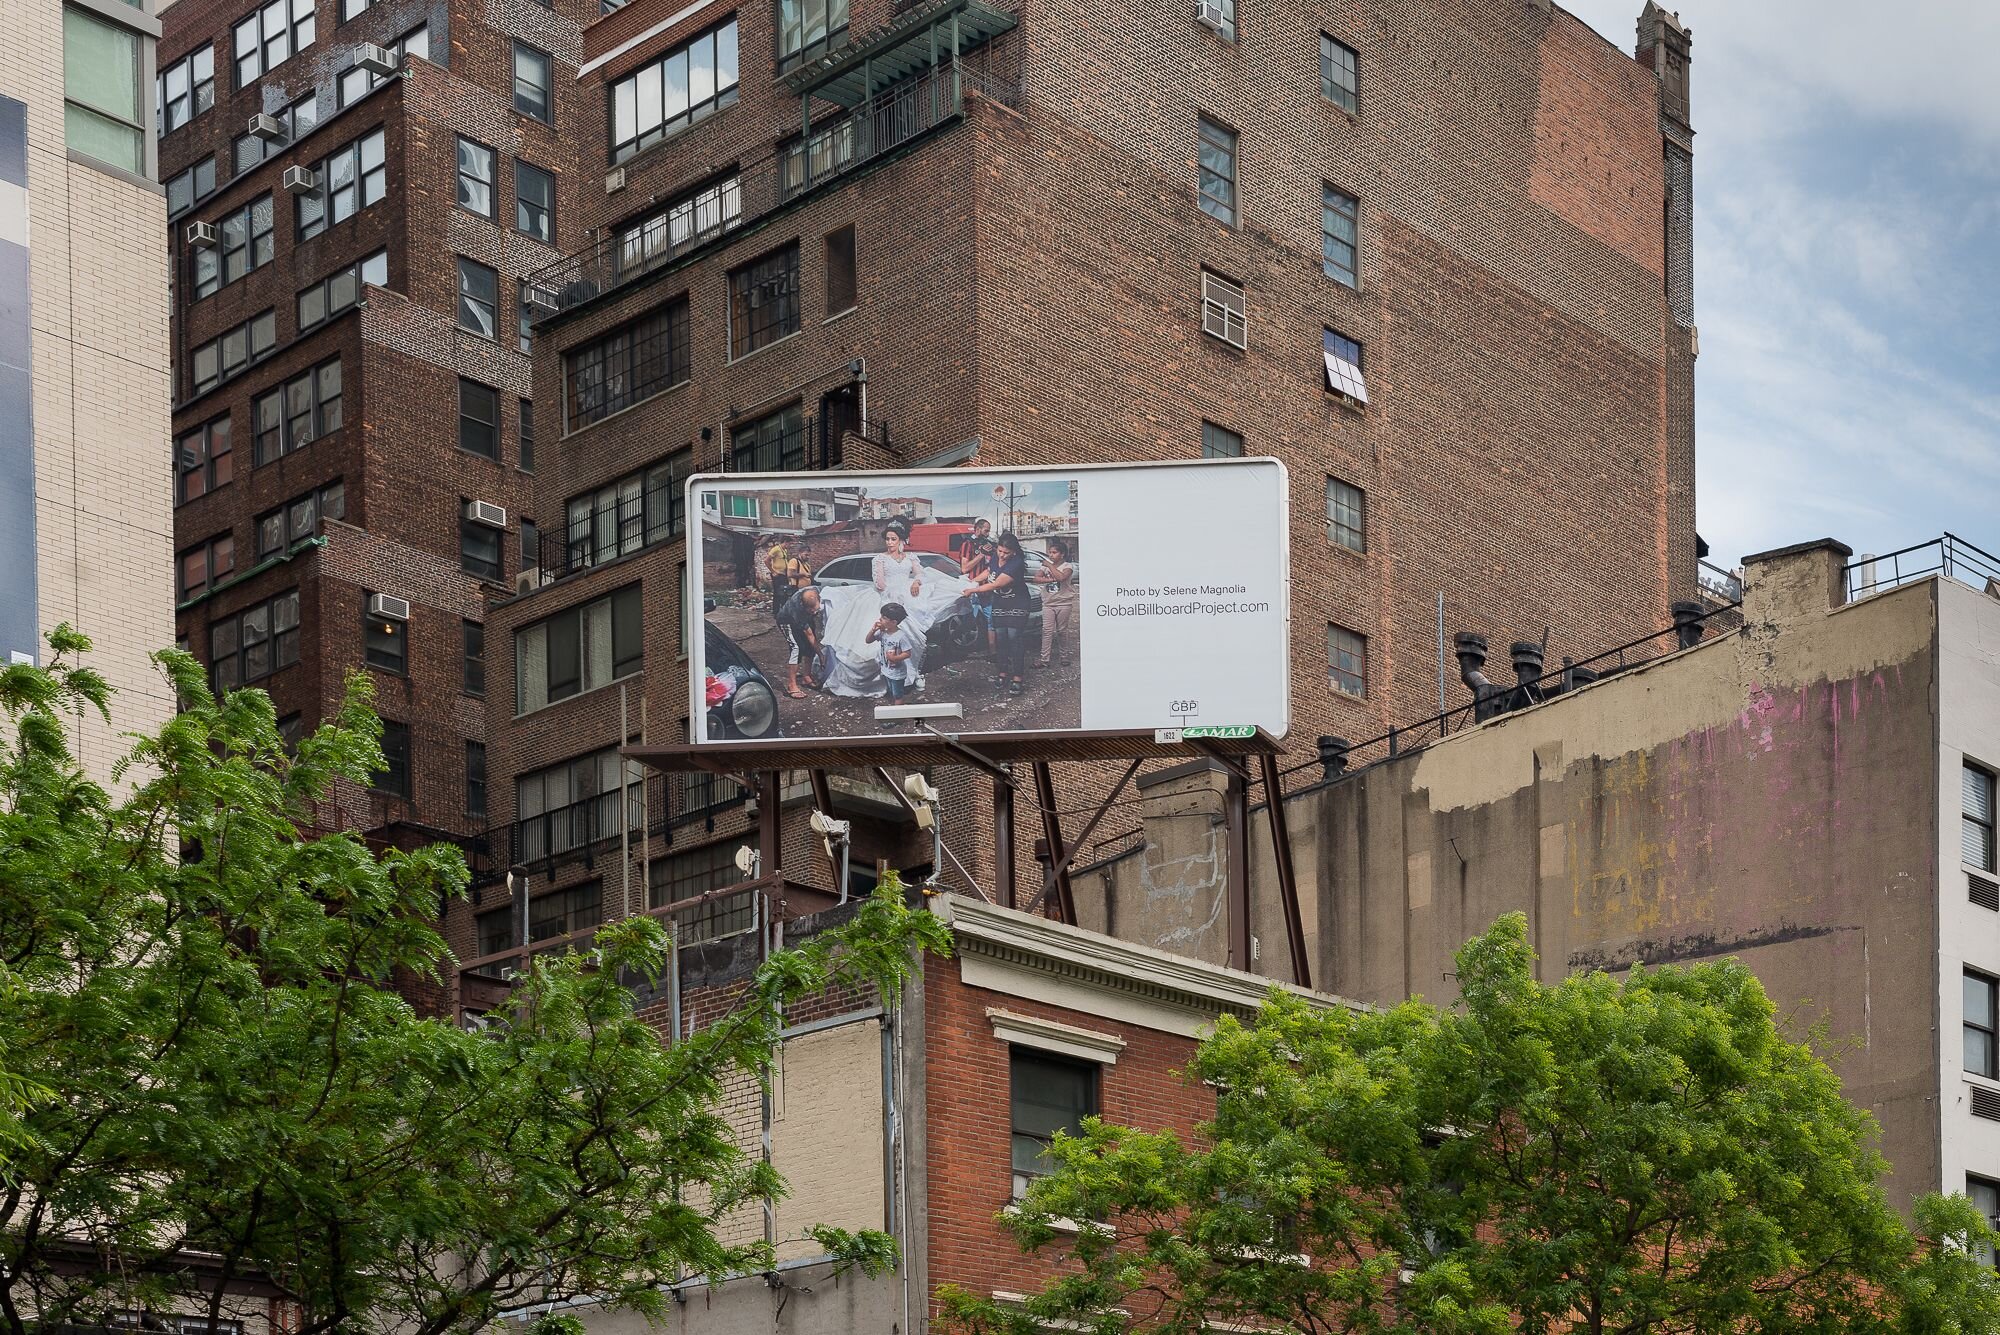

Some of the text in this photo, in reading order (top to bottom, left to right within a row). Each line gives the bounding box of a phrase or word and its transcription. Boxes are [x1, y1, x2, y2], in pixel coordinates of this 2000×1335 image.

[1116, 584, 1246, 598] Photo by Selene Magnolia
[1096, 601, 1269, 617] GlobalBillboardProject.com
[1171, 702, 1197, 712] GBP
[1186, 727, 1249, 737] LAMAR
